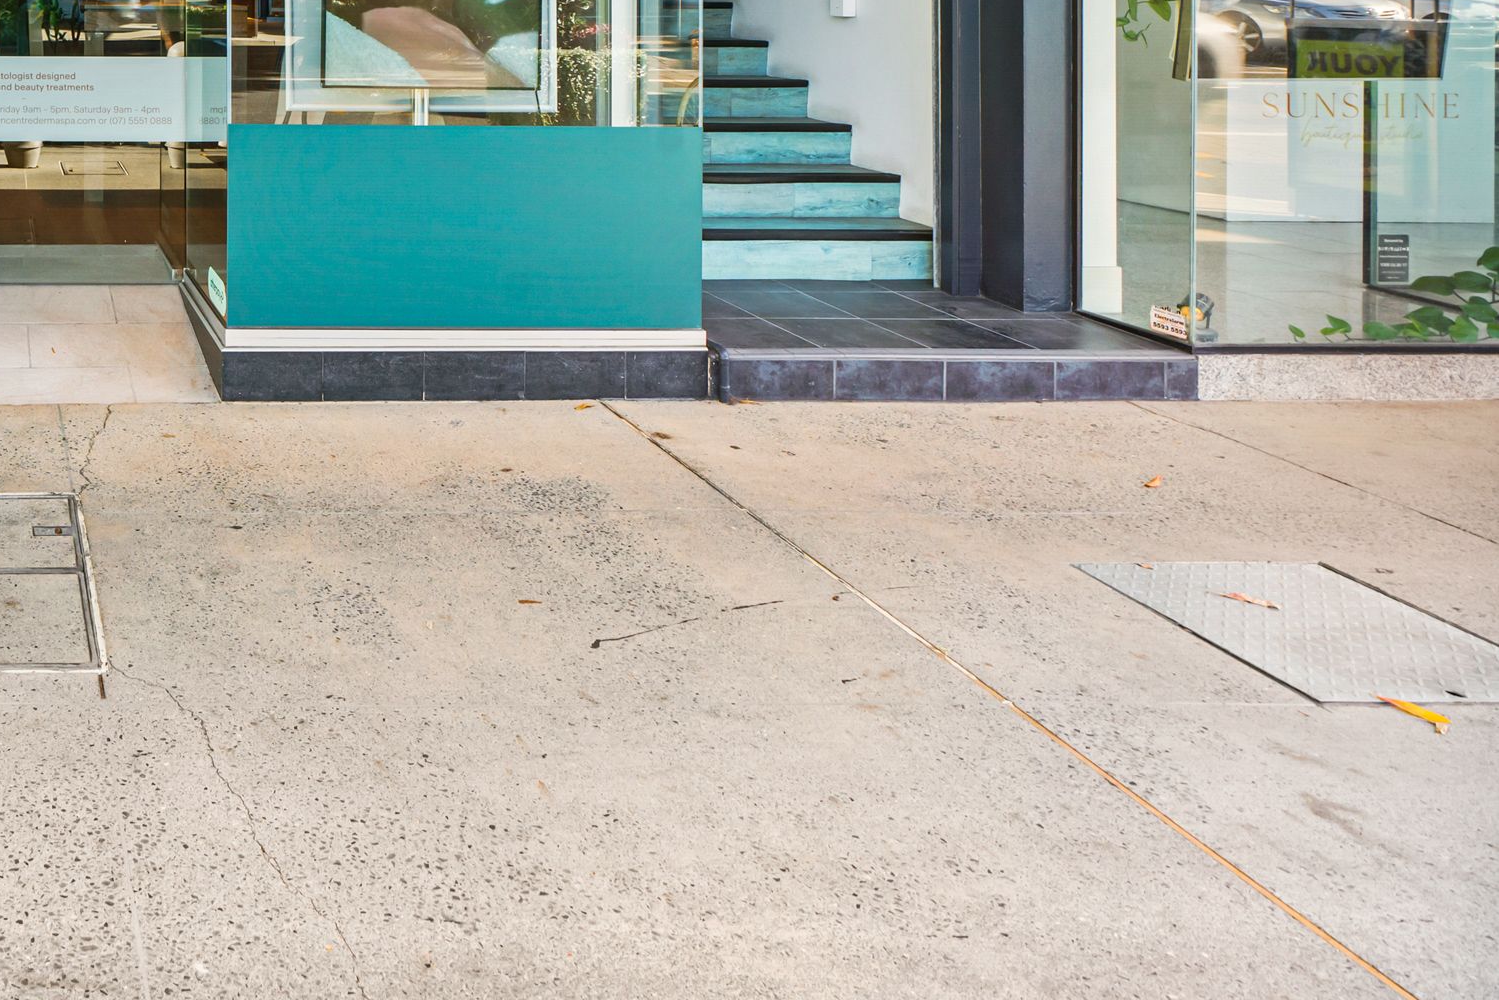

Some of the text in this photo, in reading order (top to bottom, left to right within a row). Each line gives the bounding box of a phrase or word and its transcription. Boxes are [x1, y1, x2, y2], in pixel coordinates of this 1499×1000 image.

[35, 71, 76, 82] designed
[14, 83, 44, 94] beauty
[46, 83, 94, 92] treatments
[22, 106, 42, 114] 9am
[73, 105, 111, 116] Saturday
[113, 106, 133, 114] 9am
[140, 106, 161, 116] 4pm
[1262, 92, 1460, 119] SUNSHINE
[109, 116, 126, 127] (07)
[128, 117, 148, 125] 5551
[150, 117, 173, 125] 0888
